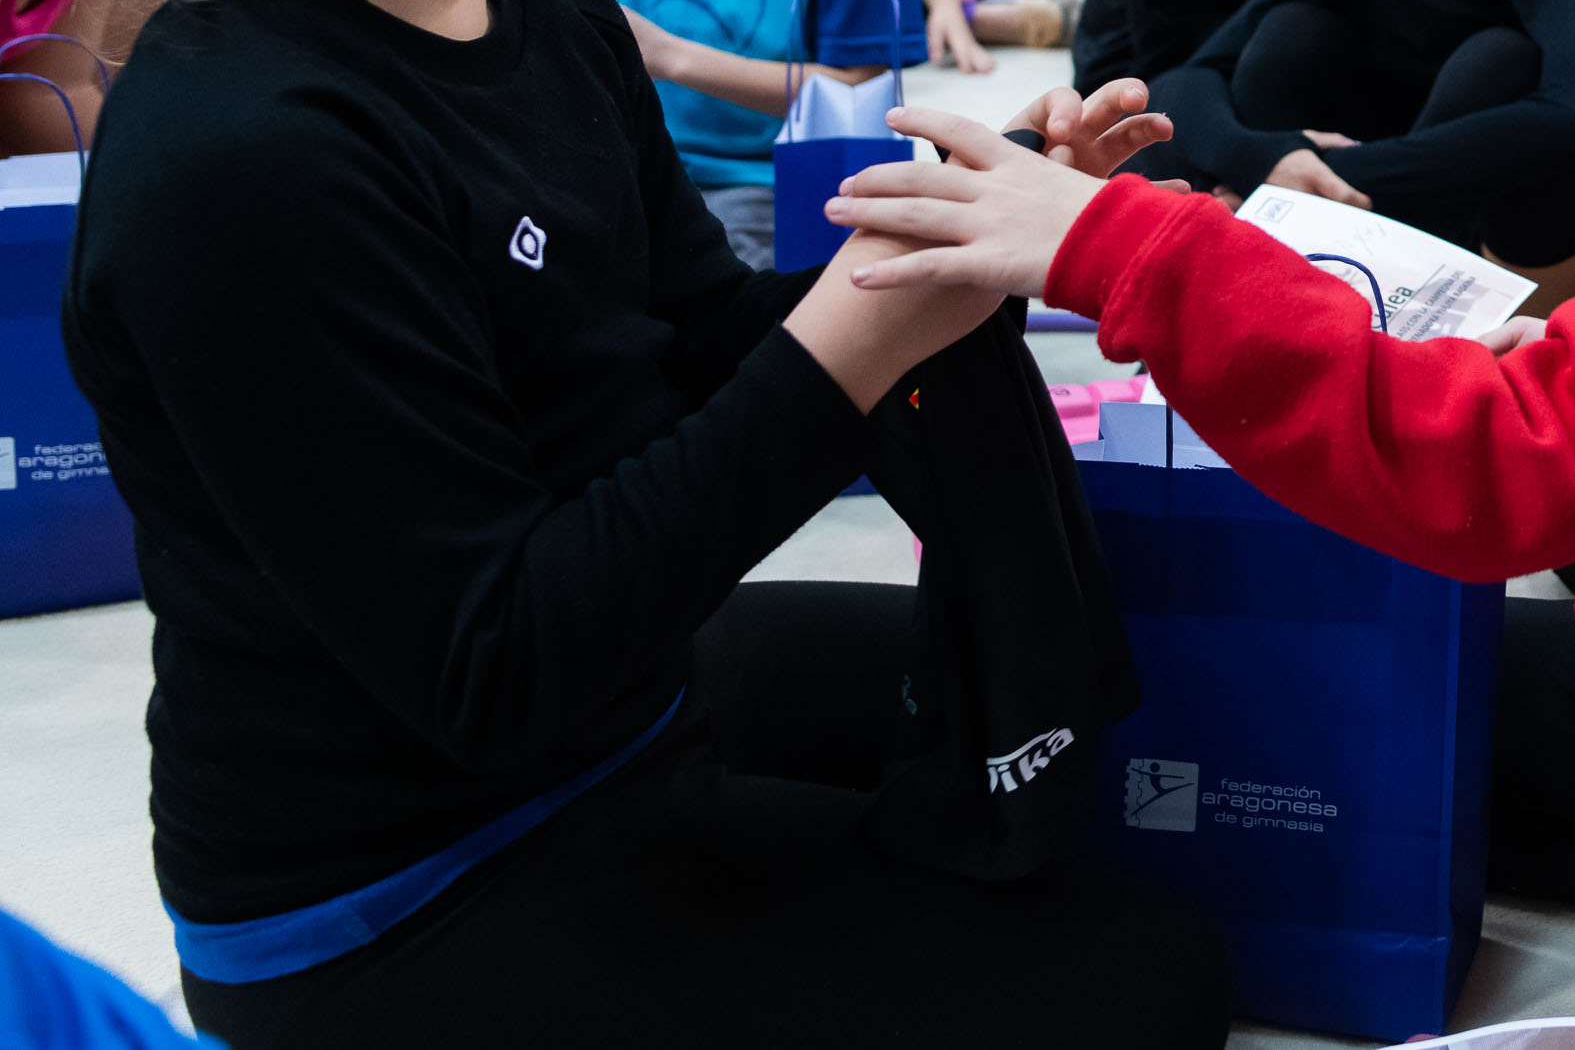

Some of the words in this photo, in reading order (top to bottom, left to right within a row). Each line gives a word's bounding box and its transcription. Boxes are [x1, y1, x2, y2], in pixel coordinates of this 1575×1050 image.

[31, 469, 54, 480] de
[1221, 778, 1321, 800] federación
[1202, 792, 1338, 817] aragonesa
[1215, 812, 1238, 824] de
[1242, 814, 1324, 833] gimnasia
